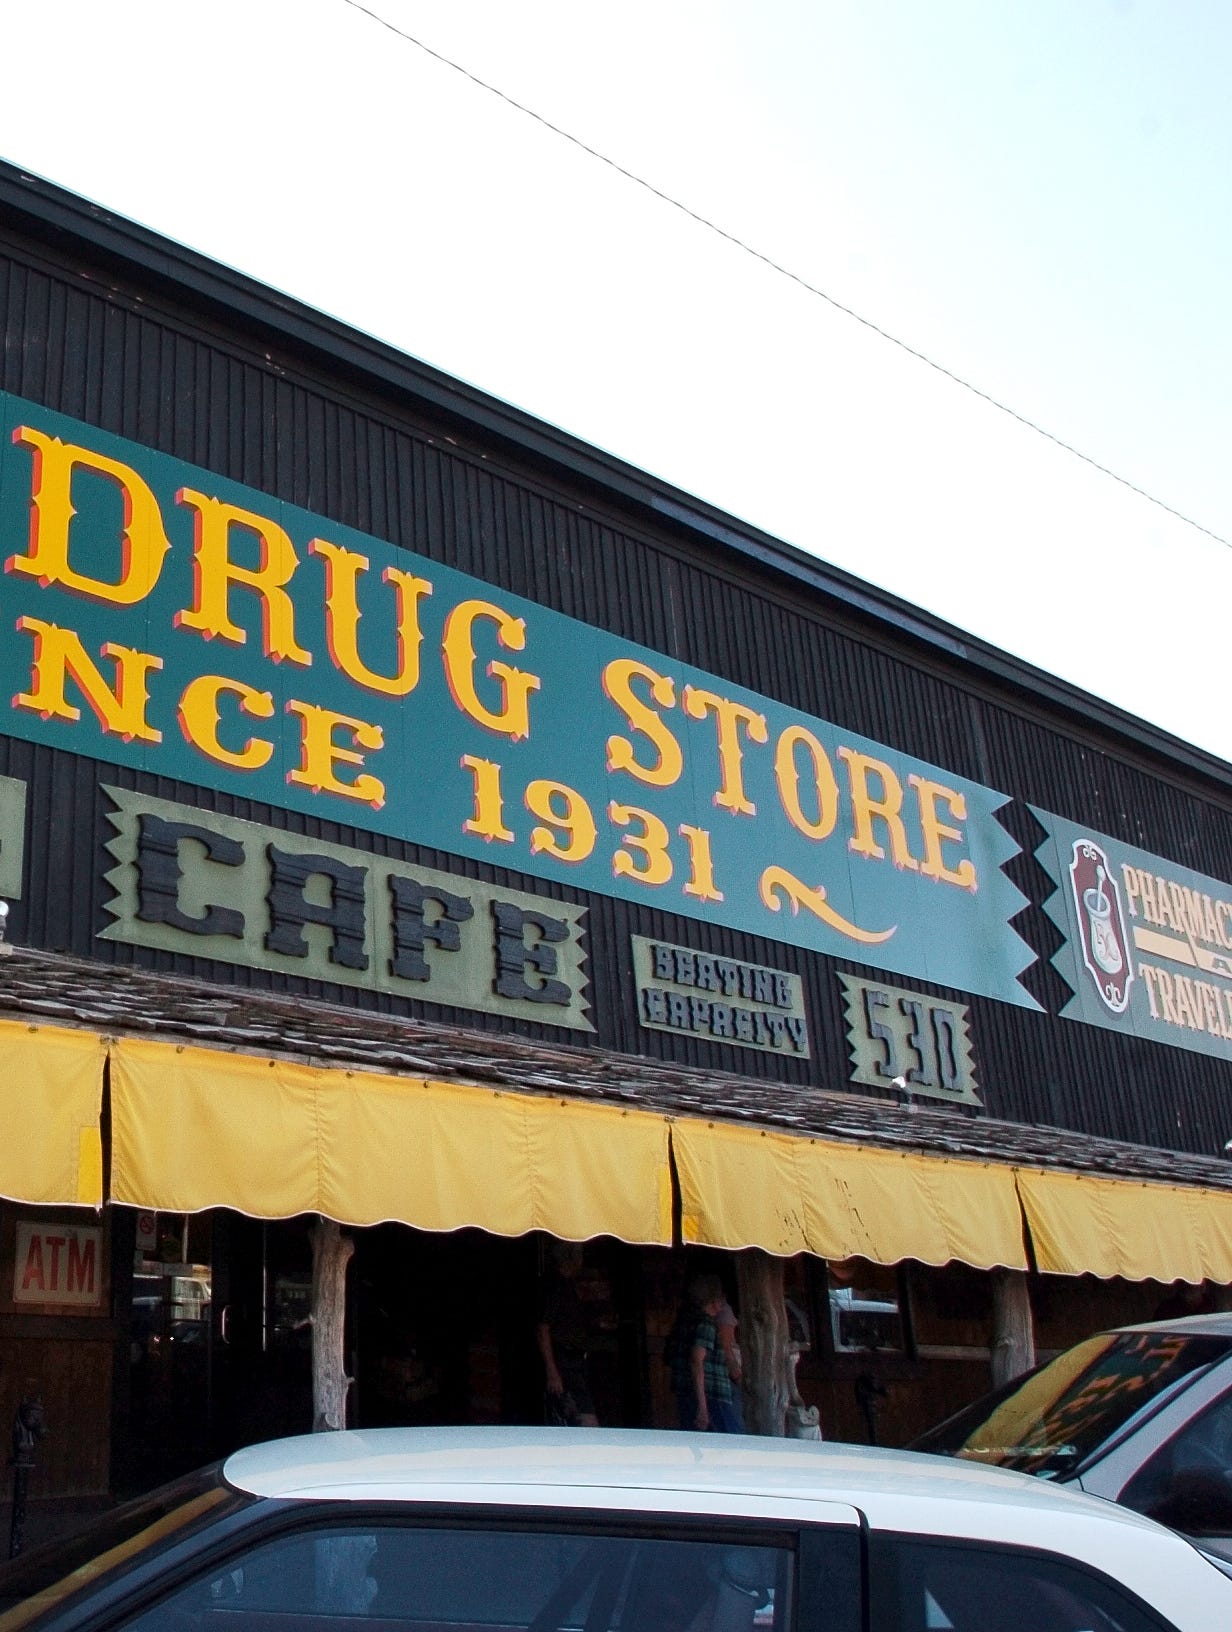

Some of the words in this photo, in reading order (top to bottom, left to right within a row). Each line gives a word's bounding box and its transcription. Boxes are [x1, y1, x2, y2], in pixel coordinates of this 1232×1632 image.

[4, 425, 541, 743] DRUG
[602, 658, 978, 894] STORE
[460, 754, 725, 904] 1931
[132, 813, 572, 1007] CAFE
[641, 988, 807, 1053] CAPACITY
[650, 944, 793, 1010] SEATING
[862, 988, 964, 1092] 530
[22, 1235, 95, 1293] ATM
